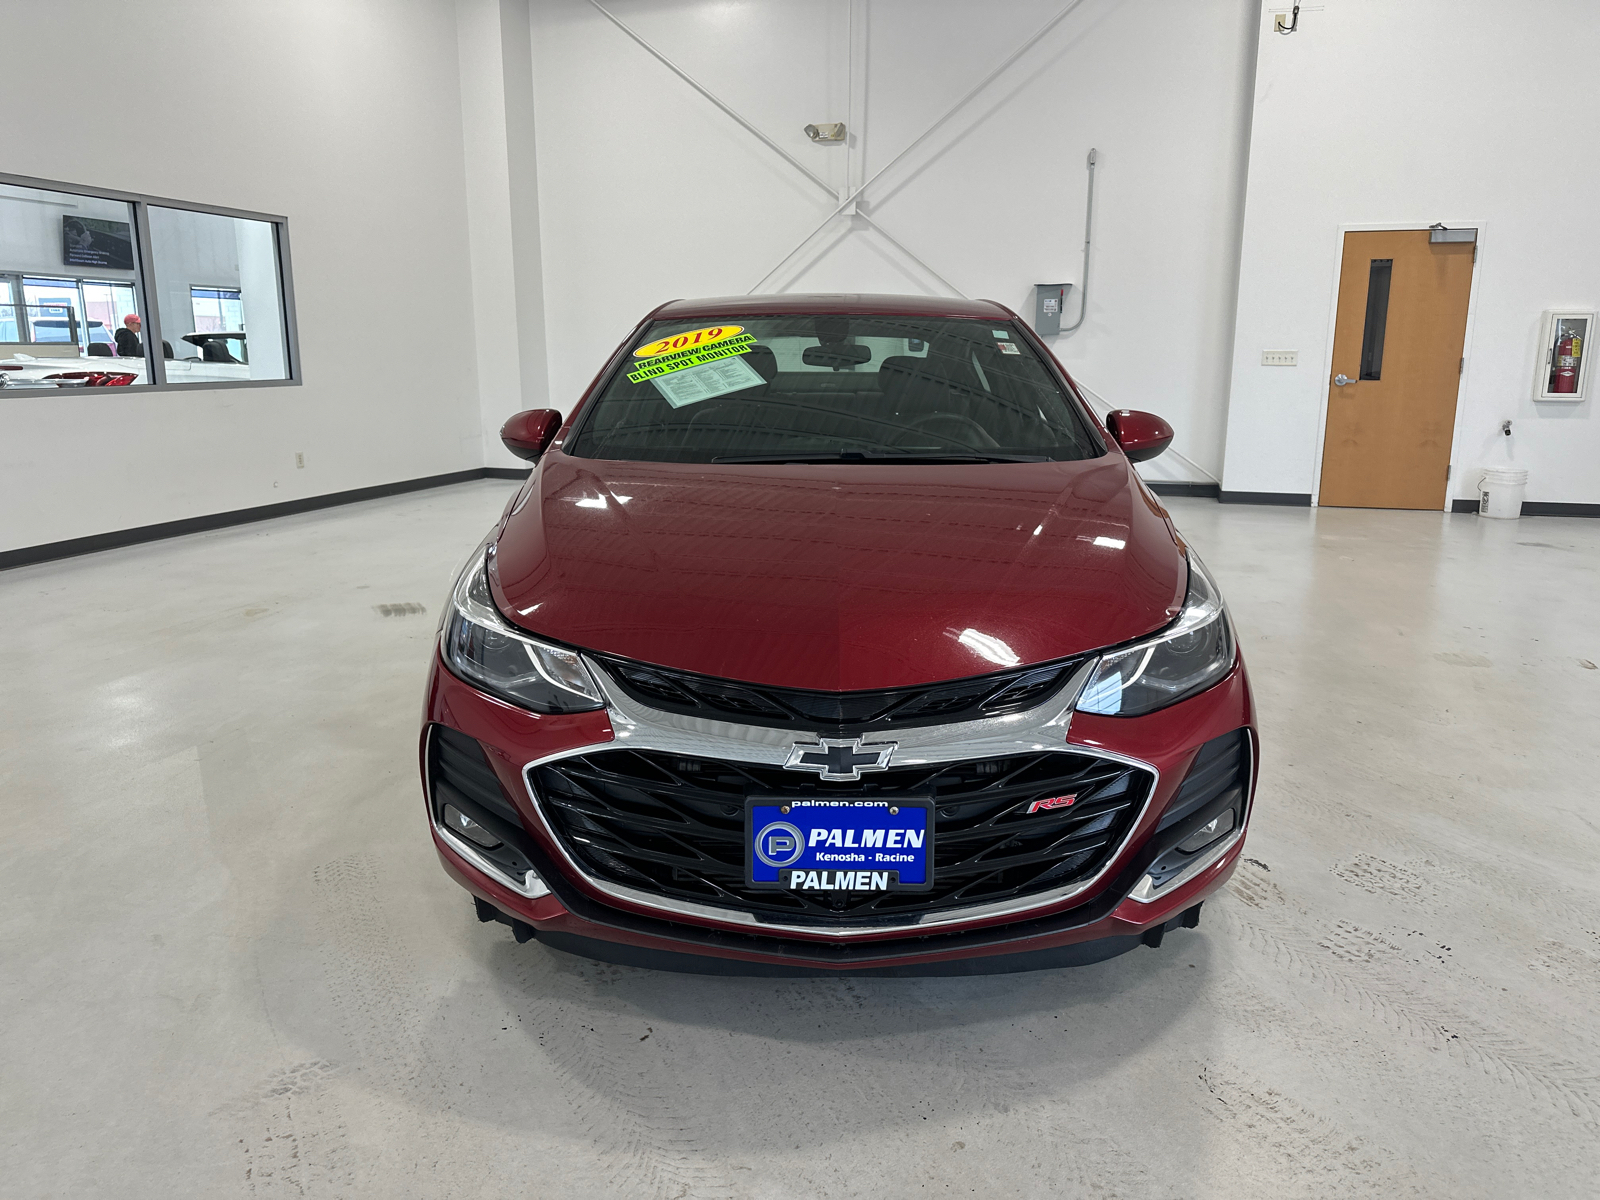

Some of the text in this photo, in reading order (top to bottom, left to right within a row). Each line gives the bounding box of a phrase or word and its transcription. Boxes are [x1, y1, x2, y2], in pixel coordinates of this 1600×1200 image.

[655, 327, 723, 355] 2019
[702, 335, 752, 351] CAMERA
[630, 344, 748, 381] BLIND SPOT MONITOR
[791, 800, 888, 808] palmen.com
[1026, 793, 1078, 814] RS
[808, 828, 925, 848] PALMEN
[816, 852, 865, 862] Kenosha
[875, 853, 915, 862] Racine
[790, 871, 888, 891] PALMEN
